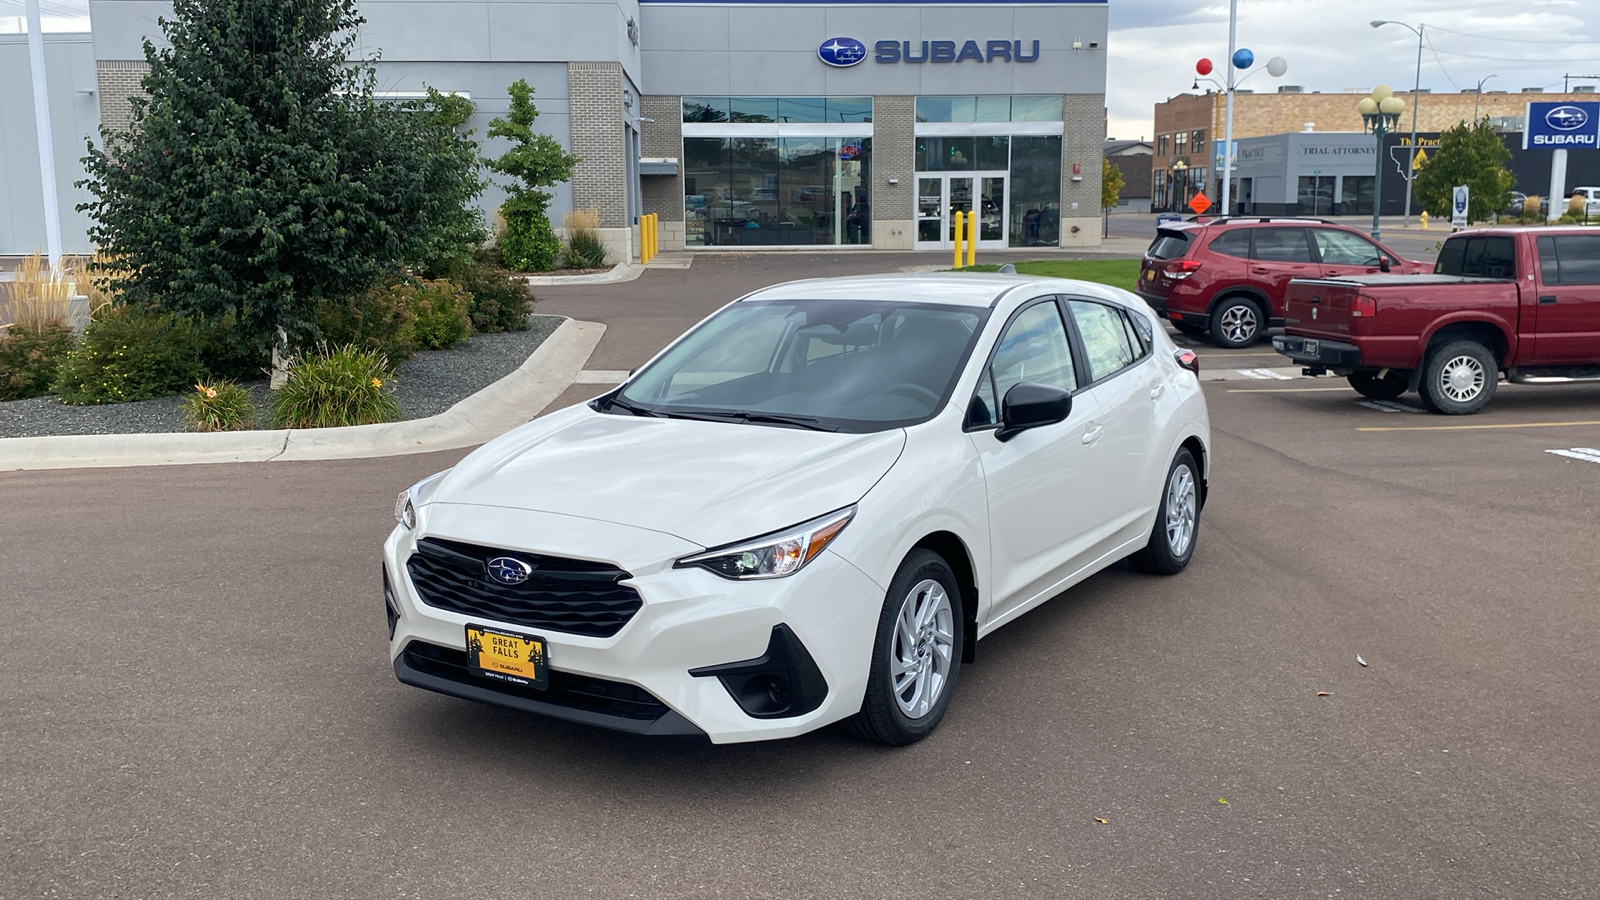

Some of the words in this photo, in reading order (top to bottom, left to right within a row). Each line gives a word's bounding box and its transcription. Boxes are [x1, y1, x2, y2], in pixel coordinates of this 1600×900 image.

[874, 40, 1040, 63] SUBARU
[1533, 134, 1595, 145] SUBARU
[1303, 147, 1330, 155] TRIAL
[492, 637, 518, 649] GREAT
[493, 646, 519, 658] FALLS
[499, 664, 523, 673] SUBARU
